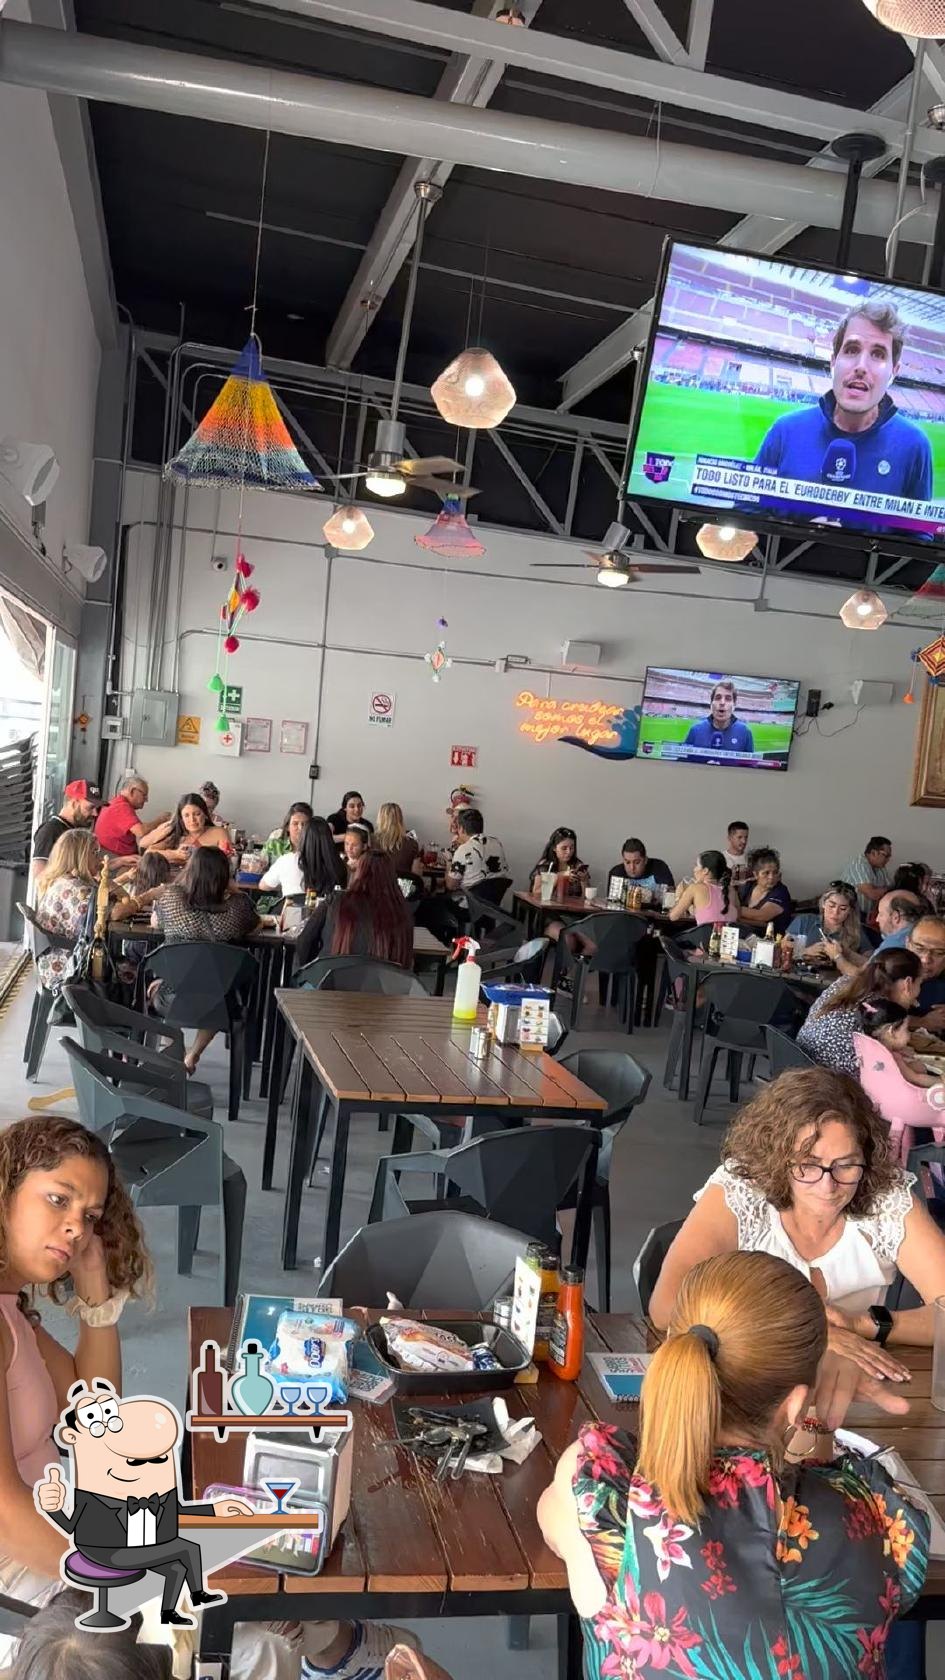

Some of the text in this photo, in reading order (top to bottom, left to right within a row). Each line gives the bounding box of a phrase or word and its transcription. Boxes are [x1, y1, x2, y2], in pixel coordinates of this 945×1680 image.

[696, 467, 721, 482] TODO
[723, 472, 750, 488] LISTO
[752, 476, 776, 492] PARA
[779, 480, 789, 494] EL
[853, 492, 883, 509] ENTRE
[915, 503, 923, 515] E
[923, 504, 945, 519] INTE
[516, 691, 557, 709] Para
[575, 723, 618, 745] lugar
